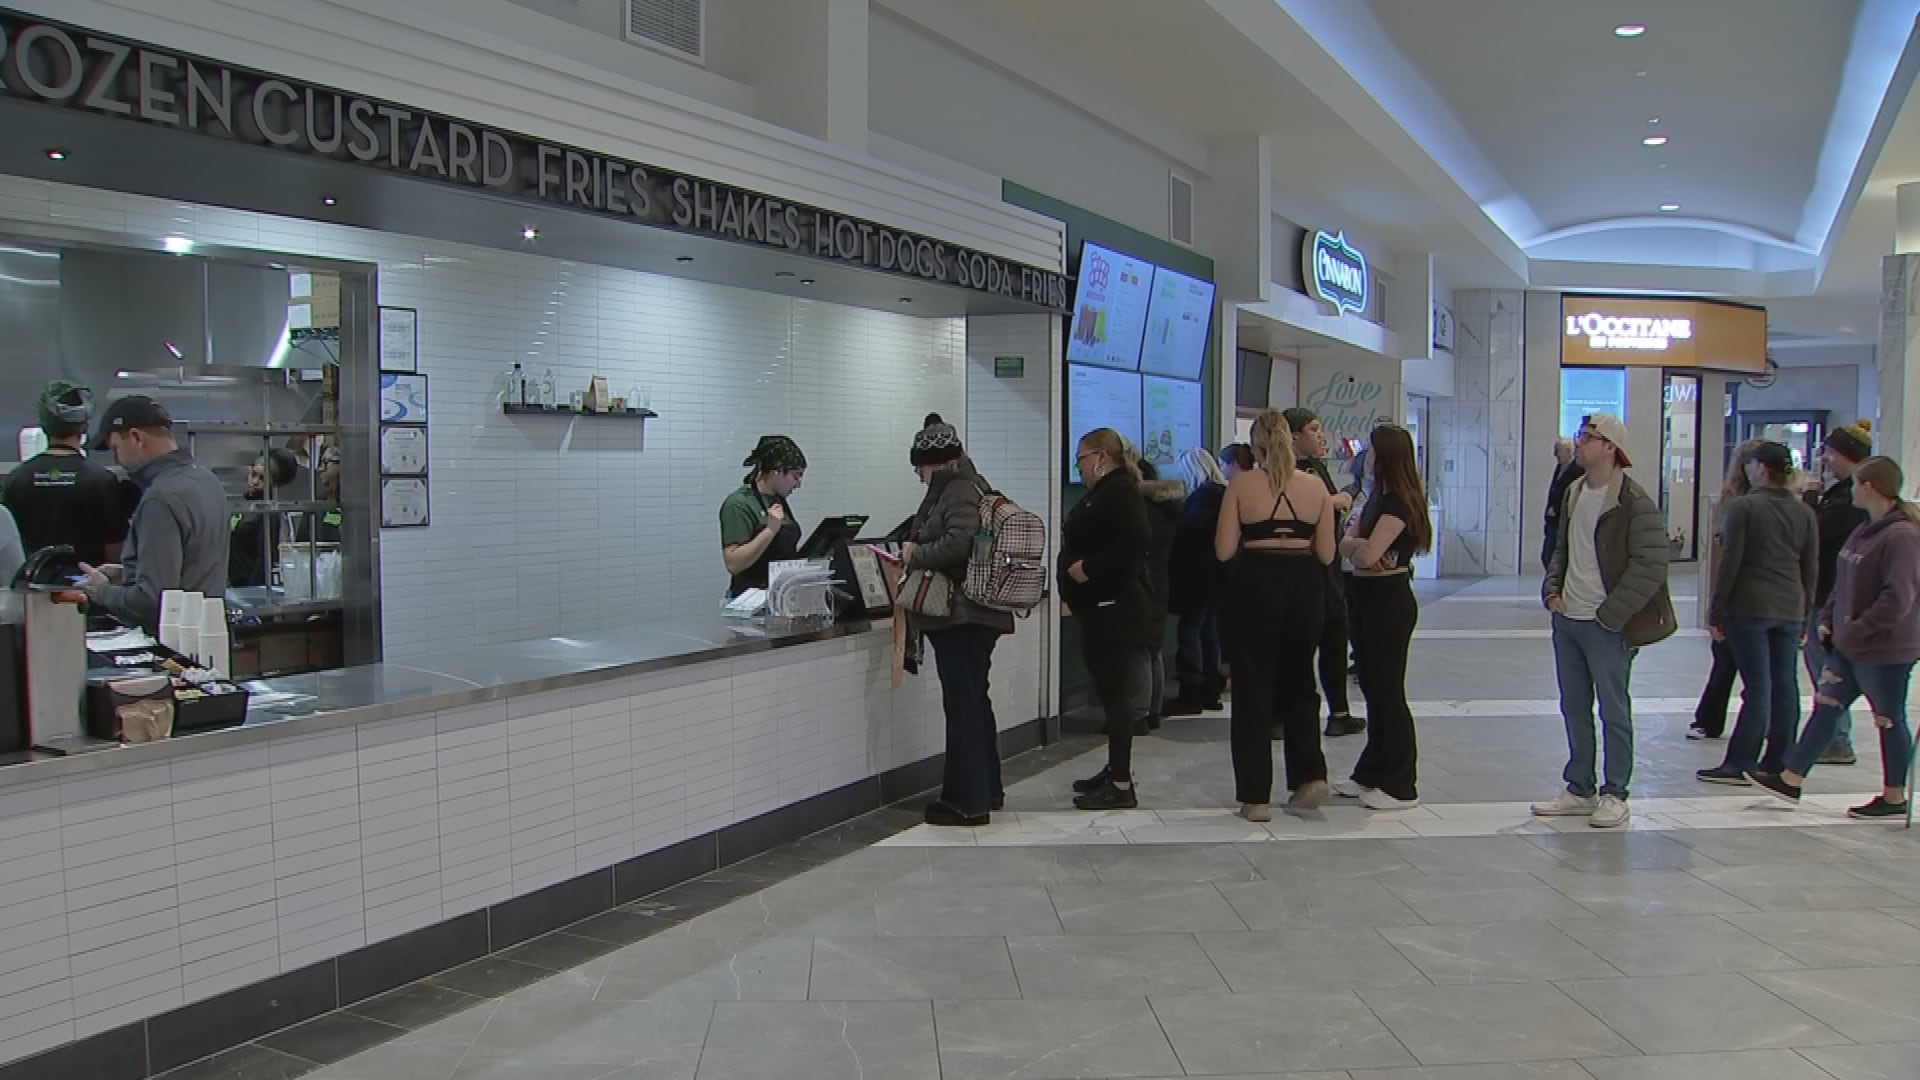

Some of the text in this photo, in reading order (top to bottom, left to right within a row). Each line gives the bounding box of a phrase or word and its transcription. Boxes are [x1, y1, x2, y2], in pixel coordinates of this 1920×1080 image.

[0, 23, 1067, 309] OZEN CUSTARD FRIES SHAKES HOT DOGS SODA FRIES
[1306, 371, 1382, 408] Love
[1318, 407, 1376, 433] aked
